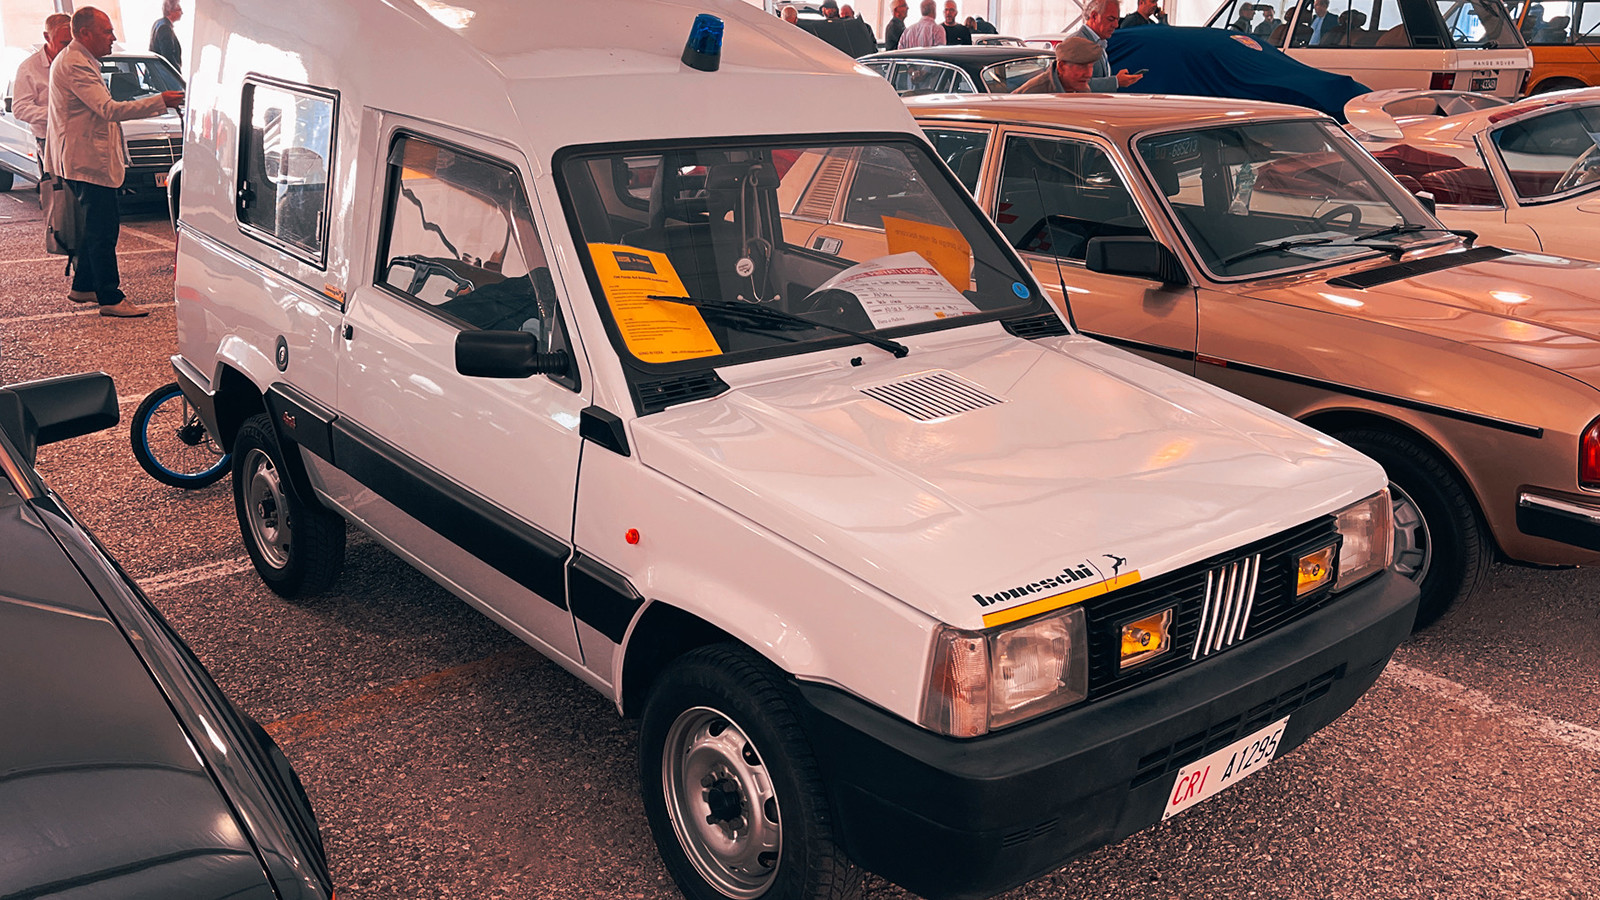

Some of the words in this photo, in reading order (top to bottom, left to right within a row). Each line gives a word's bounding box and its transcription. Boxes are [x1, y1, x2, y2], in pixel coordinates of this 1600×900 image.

[972, 563, 1094, 607] boneschi
[1172, 765, 1211, 806] CRI
[1220, 728, 1283, 782] A1295
